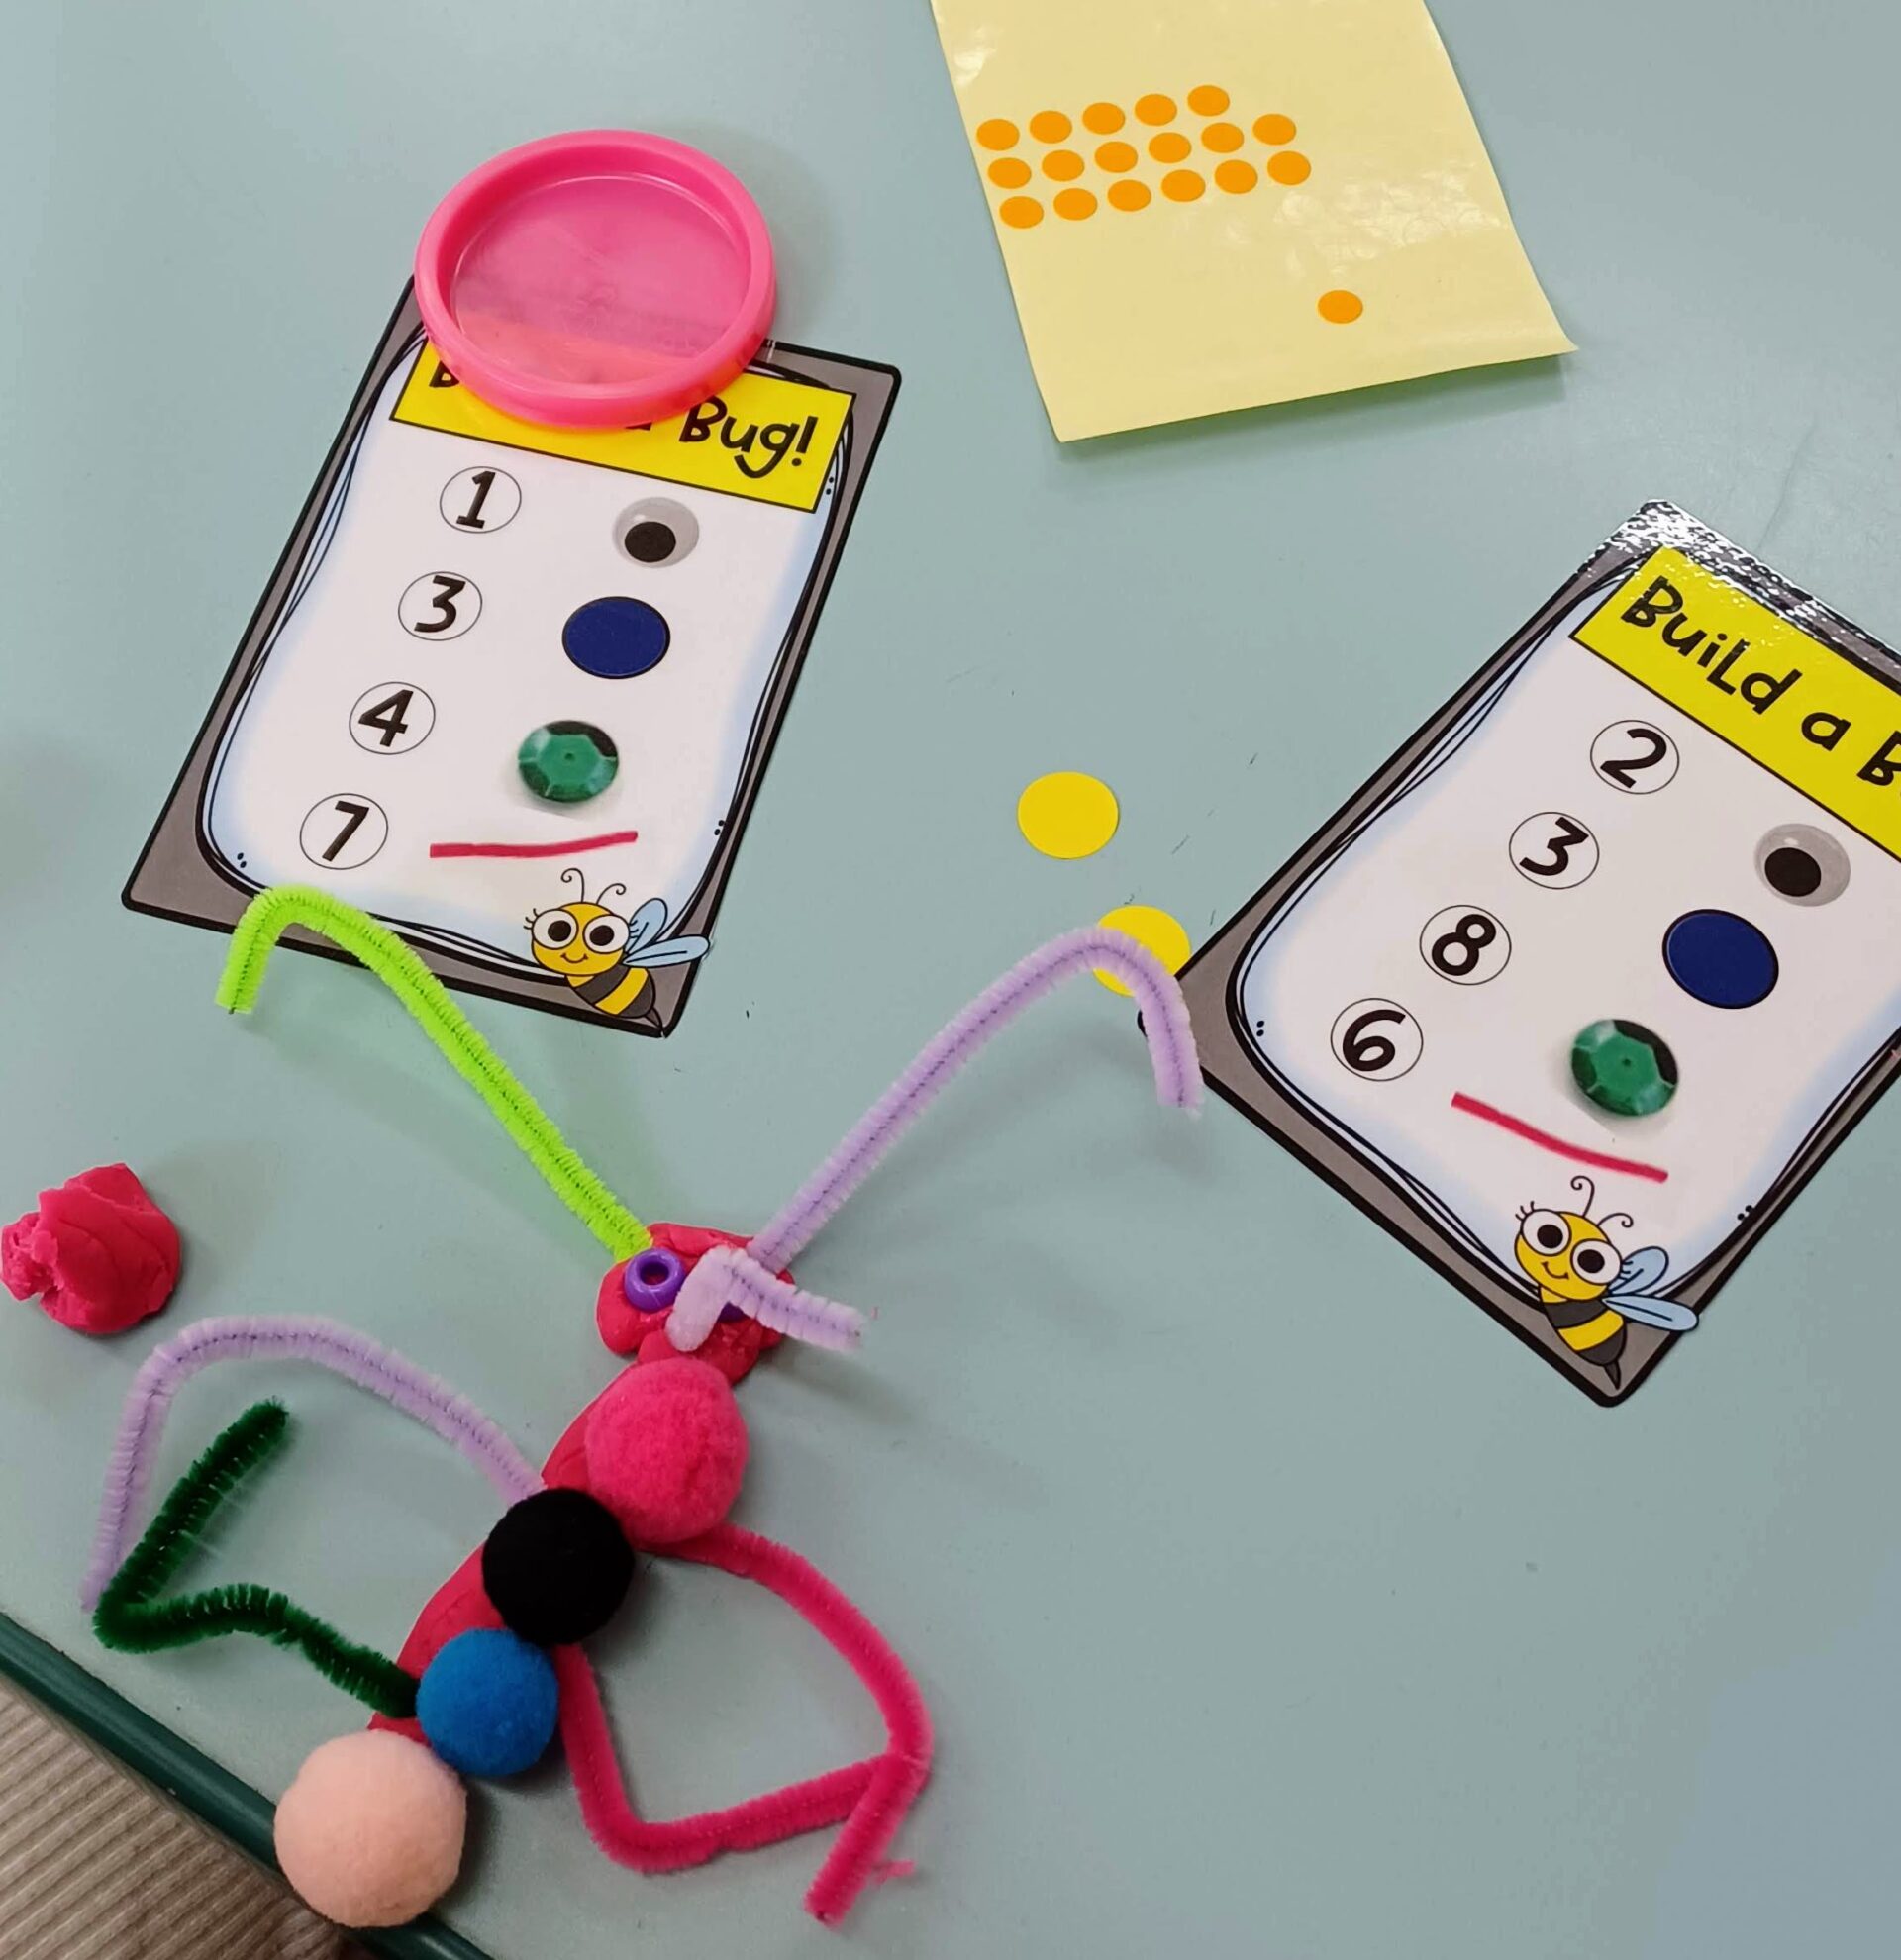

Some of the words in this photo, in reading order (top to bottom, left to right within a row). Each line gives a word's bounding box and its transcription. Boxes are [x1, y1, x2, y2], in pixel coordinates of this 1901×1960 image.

[678, 395, 819, 479] Bug!
[453, 470, 496, 529] 1
[414, 574, 467, 634] 3
[357, 688, 415, 748] 4
[1800, 711, 1852, 752] a
[1599, 727, 1668, 790] 2
[321, 799, 370, 863] 7
[1518, 816, 1590, 877] 3
[1431, 913, 1498, 977] 8
[1342, 1008, 1407, 1072] 6
